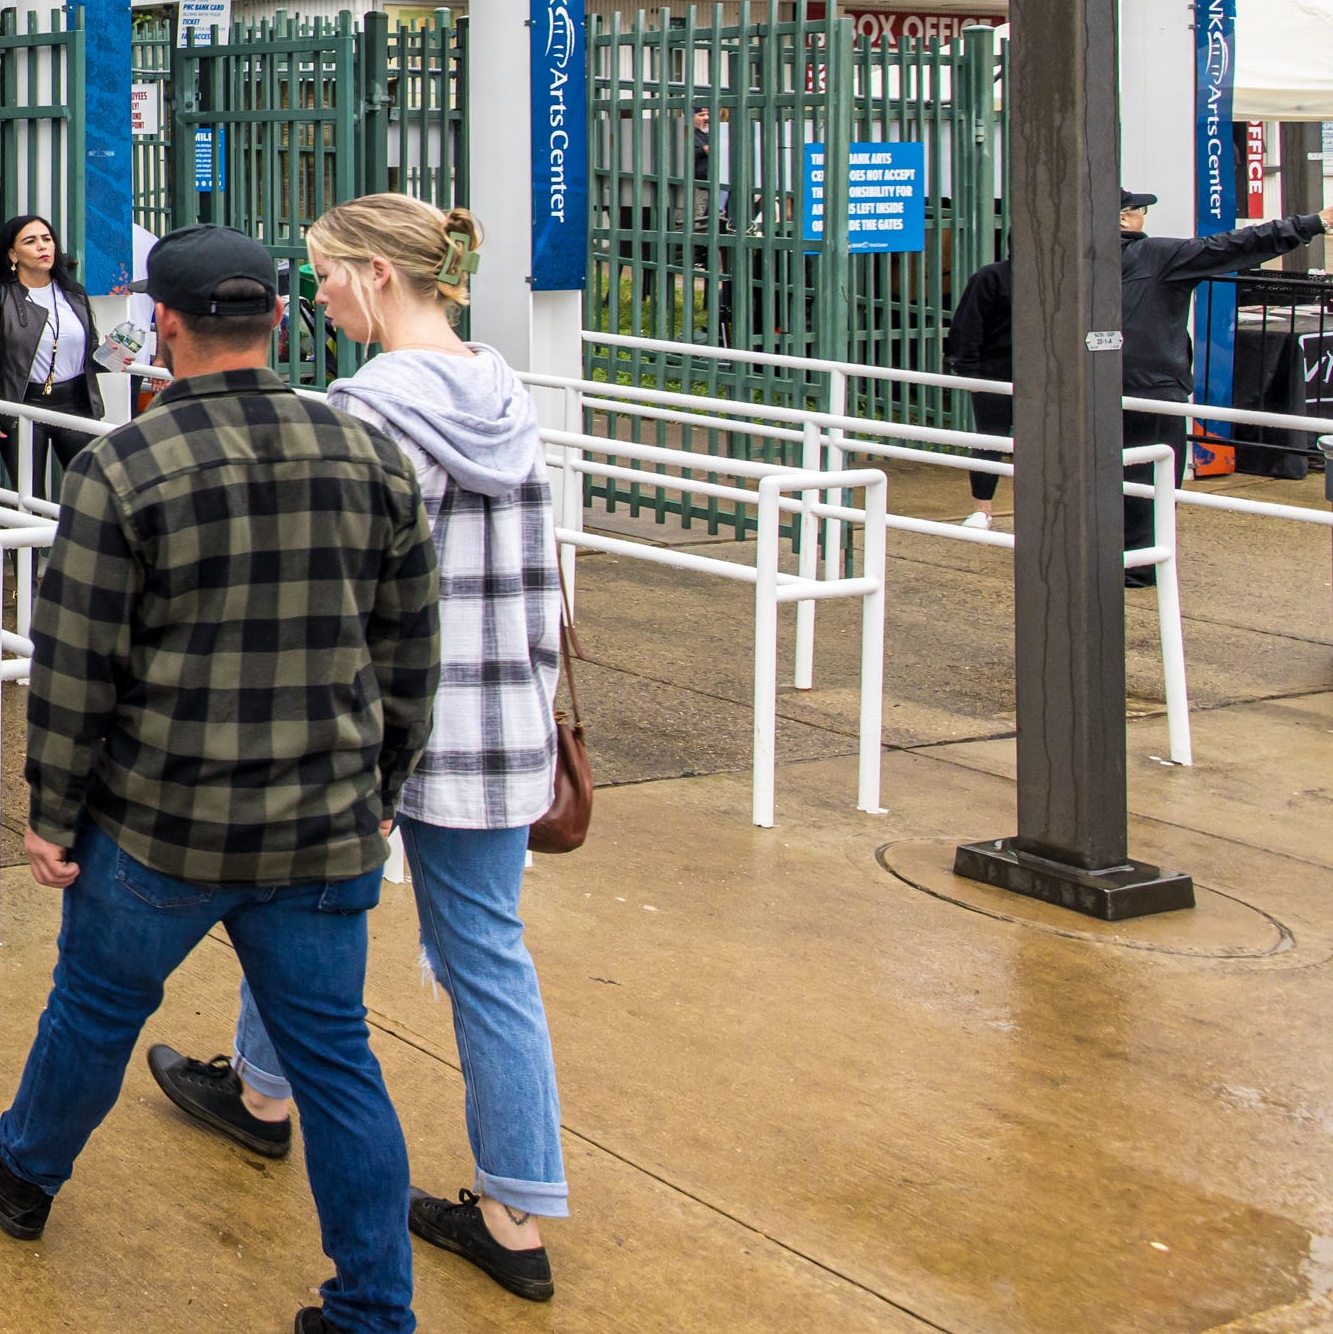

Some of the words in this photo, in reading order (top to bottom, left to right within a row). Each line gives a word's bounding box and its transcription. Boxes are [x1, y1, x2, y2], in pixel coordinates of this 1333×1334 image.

[903, 15, 992, 46] OFFI
[549, 69, 569, 127] Arts
[1208, 84, 1224, 135] Arts
[871, 153, 892, 164] ARTS
[550, 131, 569, 224] Center
[849, 170, 866, 181] OES
[867, 170, 883, 181] NOT
[884, 170, 915, 181] ACCEPT
[1208, 138, 1223, 220] Center
[849, 186, 895, 198] ONSIBILITY
[896, 186, 913, 197] FOR
[857, 203, 875, 214] LEFT
[876, 203, 904, 214] INSIDE
[862, 220, 877, 231] THE
[878, 219, 904, 230] GATES
